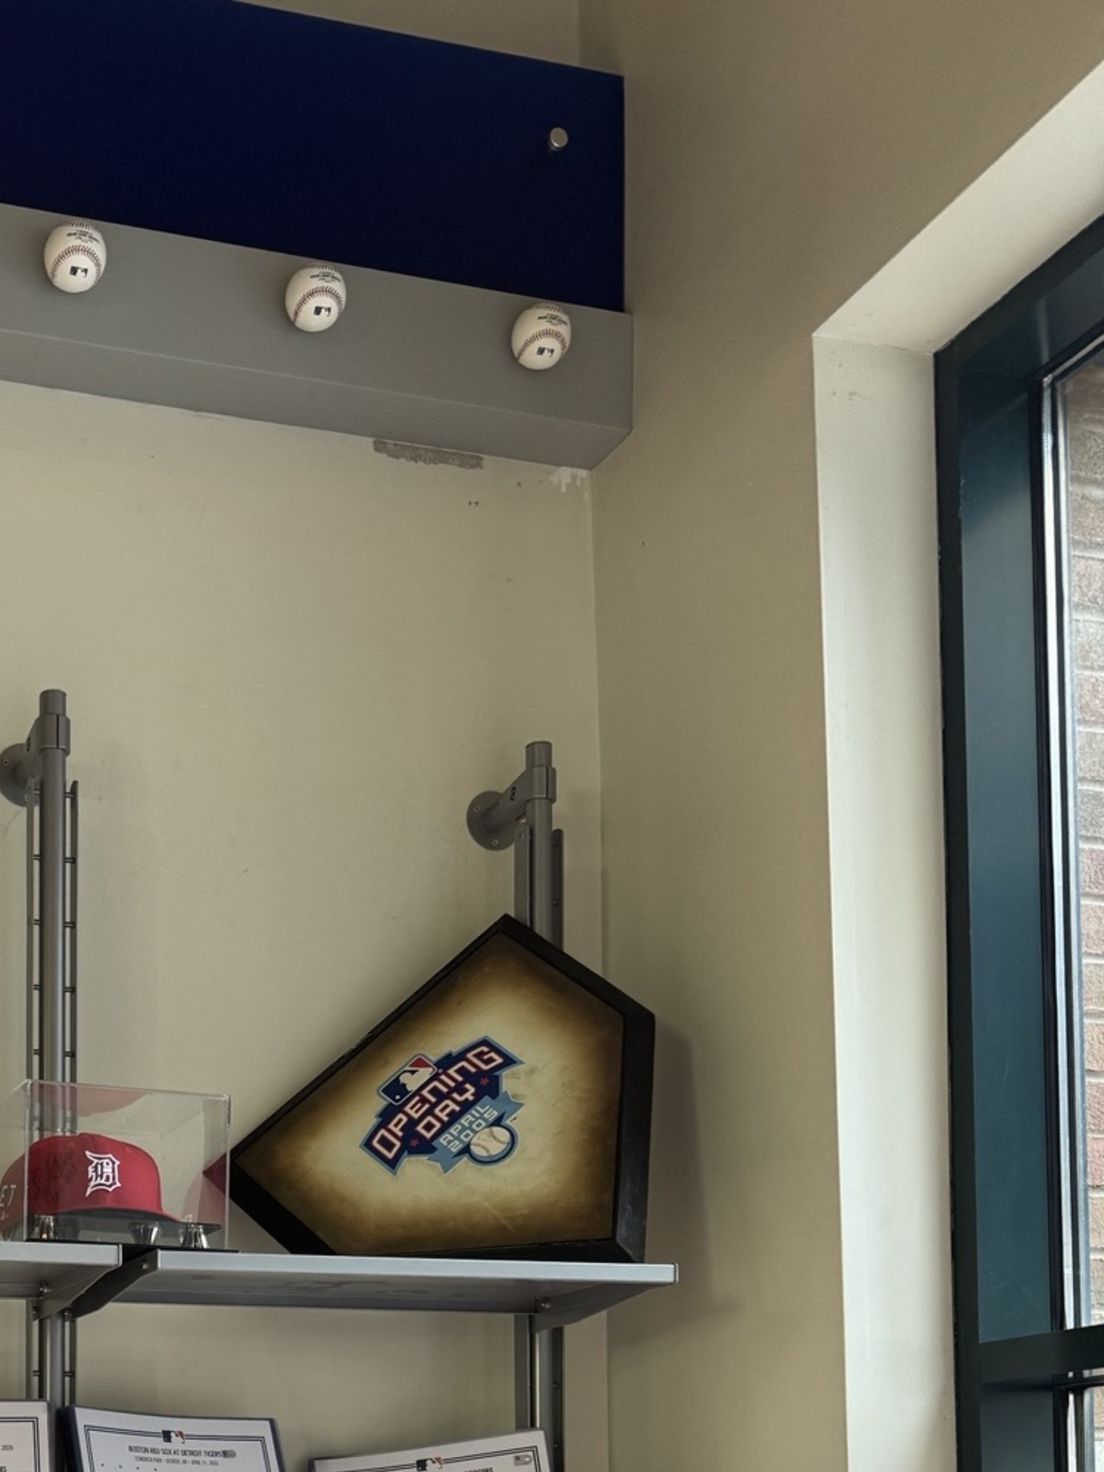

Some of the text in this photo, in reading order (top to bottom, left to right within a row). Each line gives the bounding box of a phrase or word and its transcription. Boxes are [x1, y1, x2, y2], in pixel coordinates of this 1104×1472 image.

[371, 1046, 504, 1160] OPENING
[416, 1083, 476, 1140] DAY
[440, 1105, 491, 1146] APRIL
[449, 1108, 499, 1152] 2005
